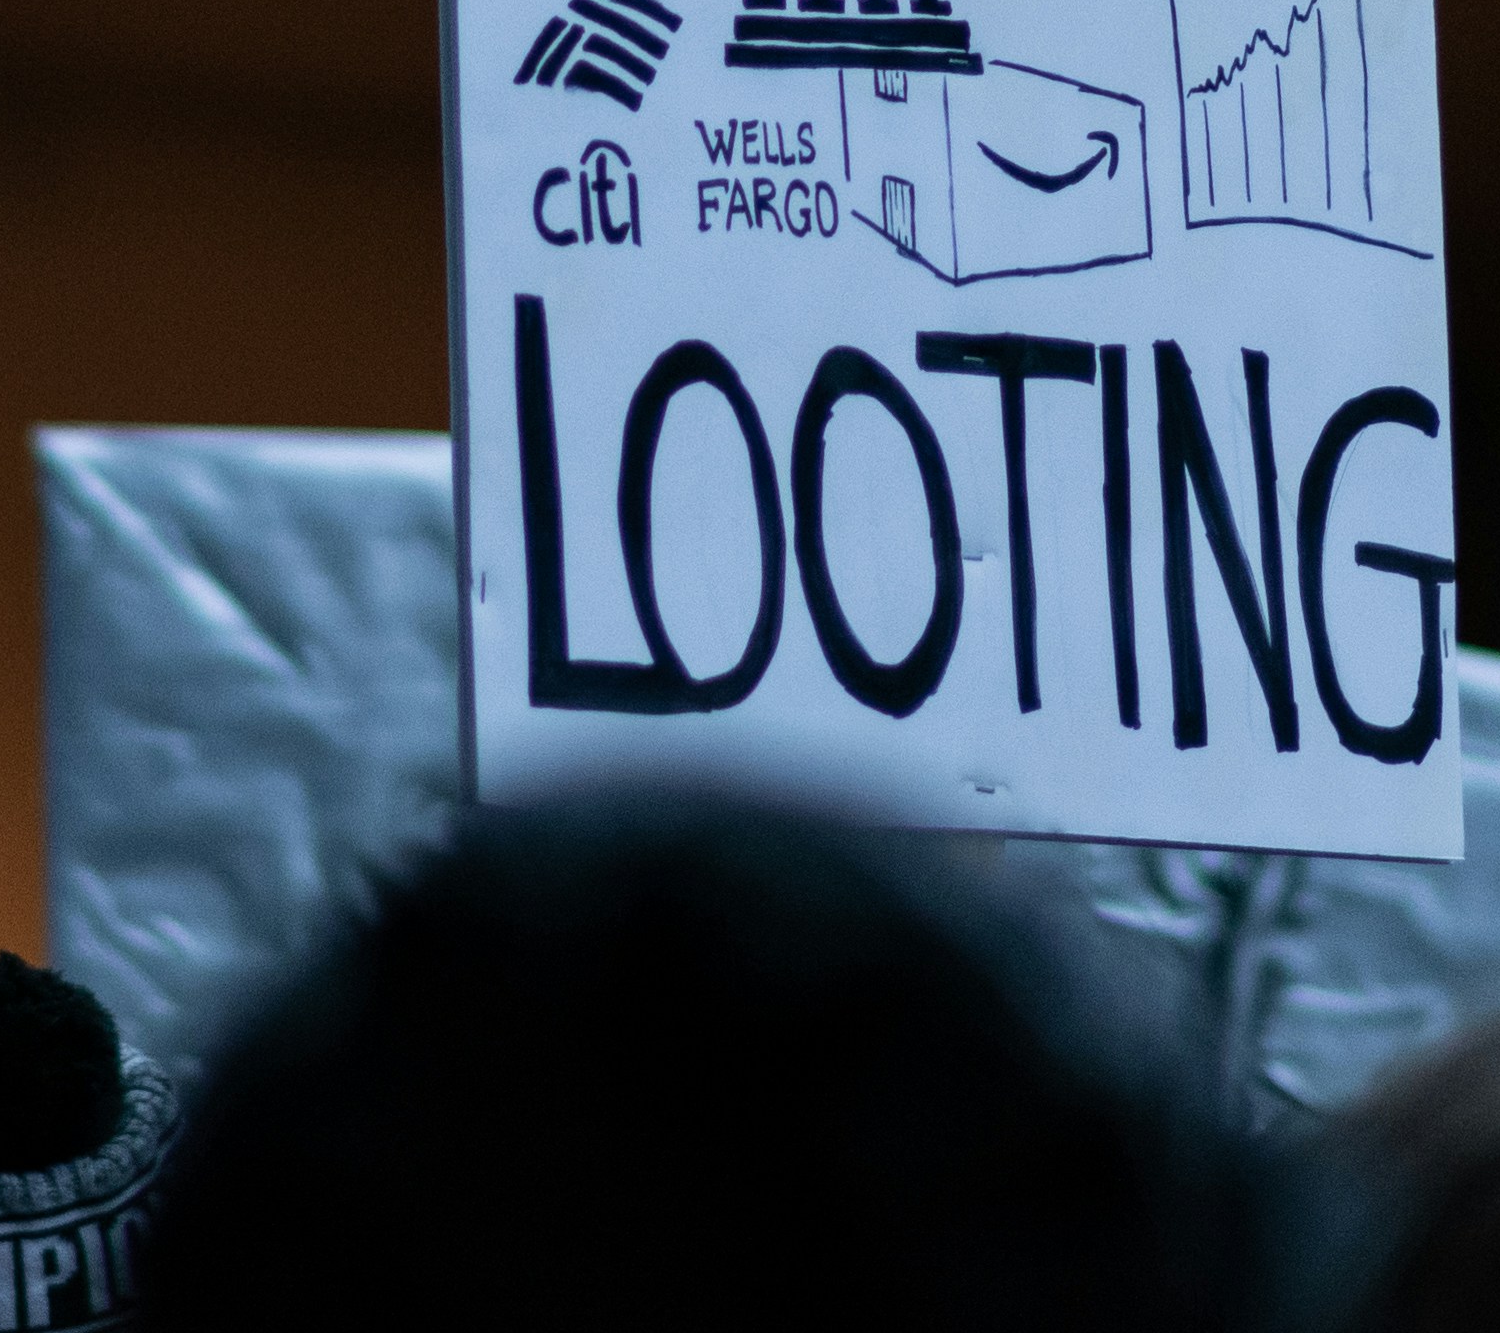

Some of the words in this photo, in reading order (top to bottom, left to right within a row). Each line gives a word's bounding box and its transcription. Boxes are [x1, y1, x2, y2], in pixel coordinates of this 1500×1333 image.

[694, 118, 817, 167] WELLS
[532, 140, 641, 247] citi
[697, 177, 839, 238] FARGO
[513, 293, 1455, 763] LOOTING
